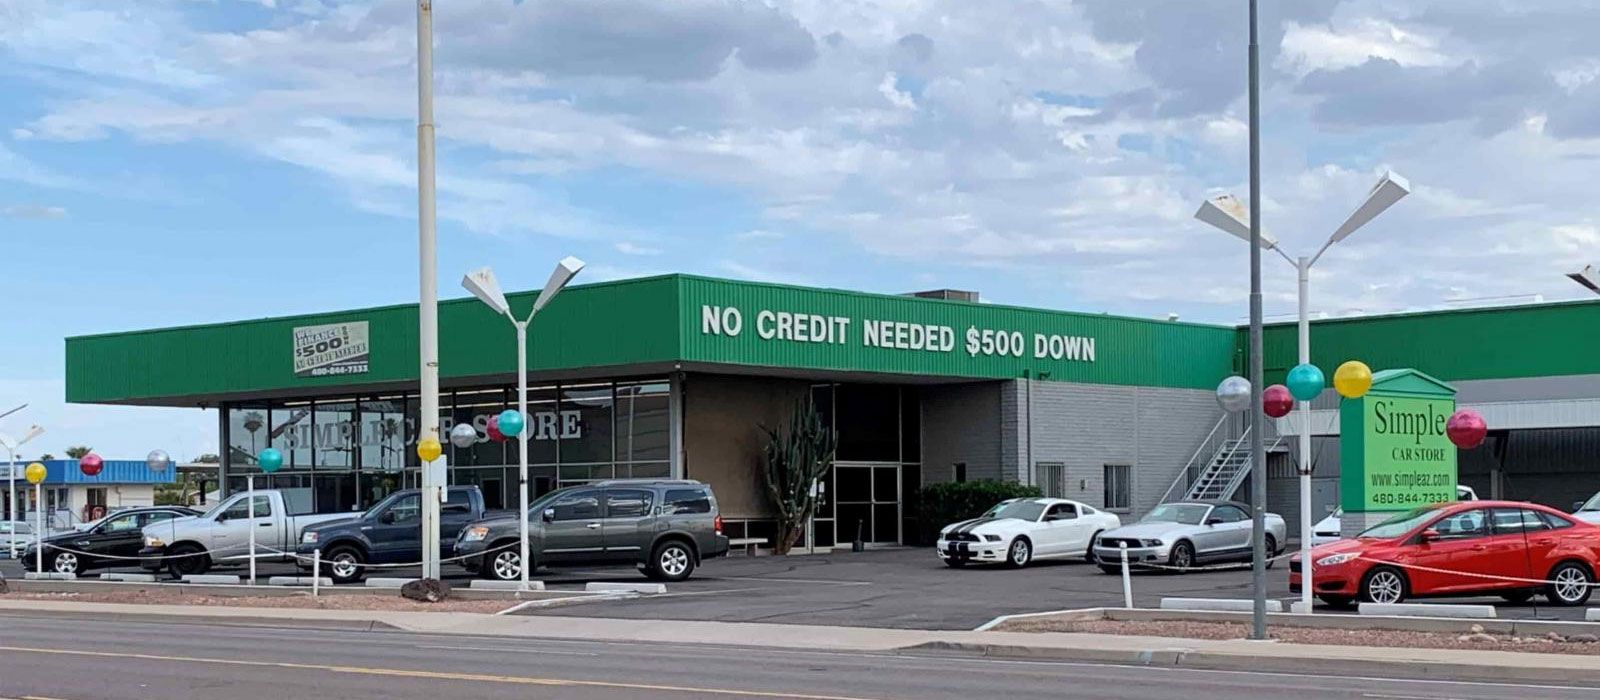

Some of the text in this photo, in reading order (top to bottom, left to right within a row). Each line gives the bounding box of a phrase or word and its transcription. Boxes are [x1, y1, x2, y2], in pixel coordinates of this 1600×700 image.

[702, 304, 1096, 361] NO CREDIT NEEDED $500 DOWN
[296, 337, 342, 358] $500
[1374, 400, 1445, 445] Simple
[283, 420, 390, 450] SIMPLE
[1392, 447, 1446, 462] CAR STORE
[1371, 470, 1450, 490] www.simpleaz.com
[1372, 492, 1449, 504] 480-844-7333
